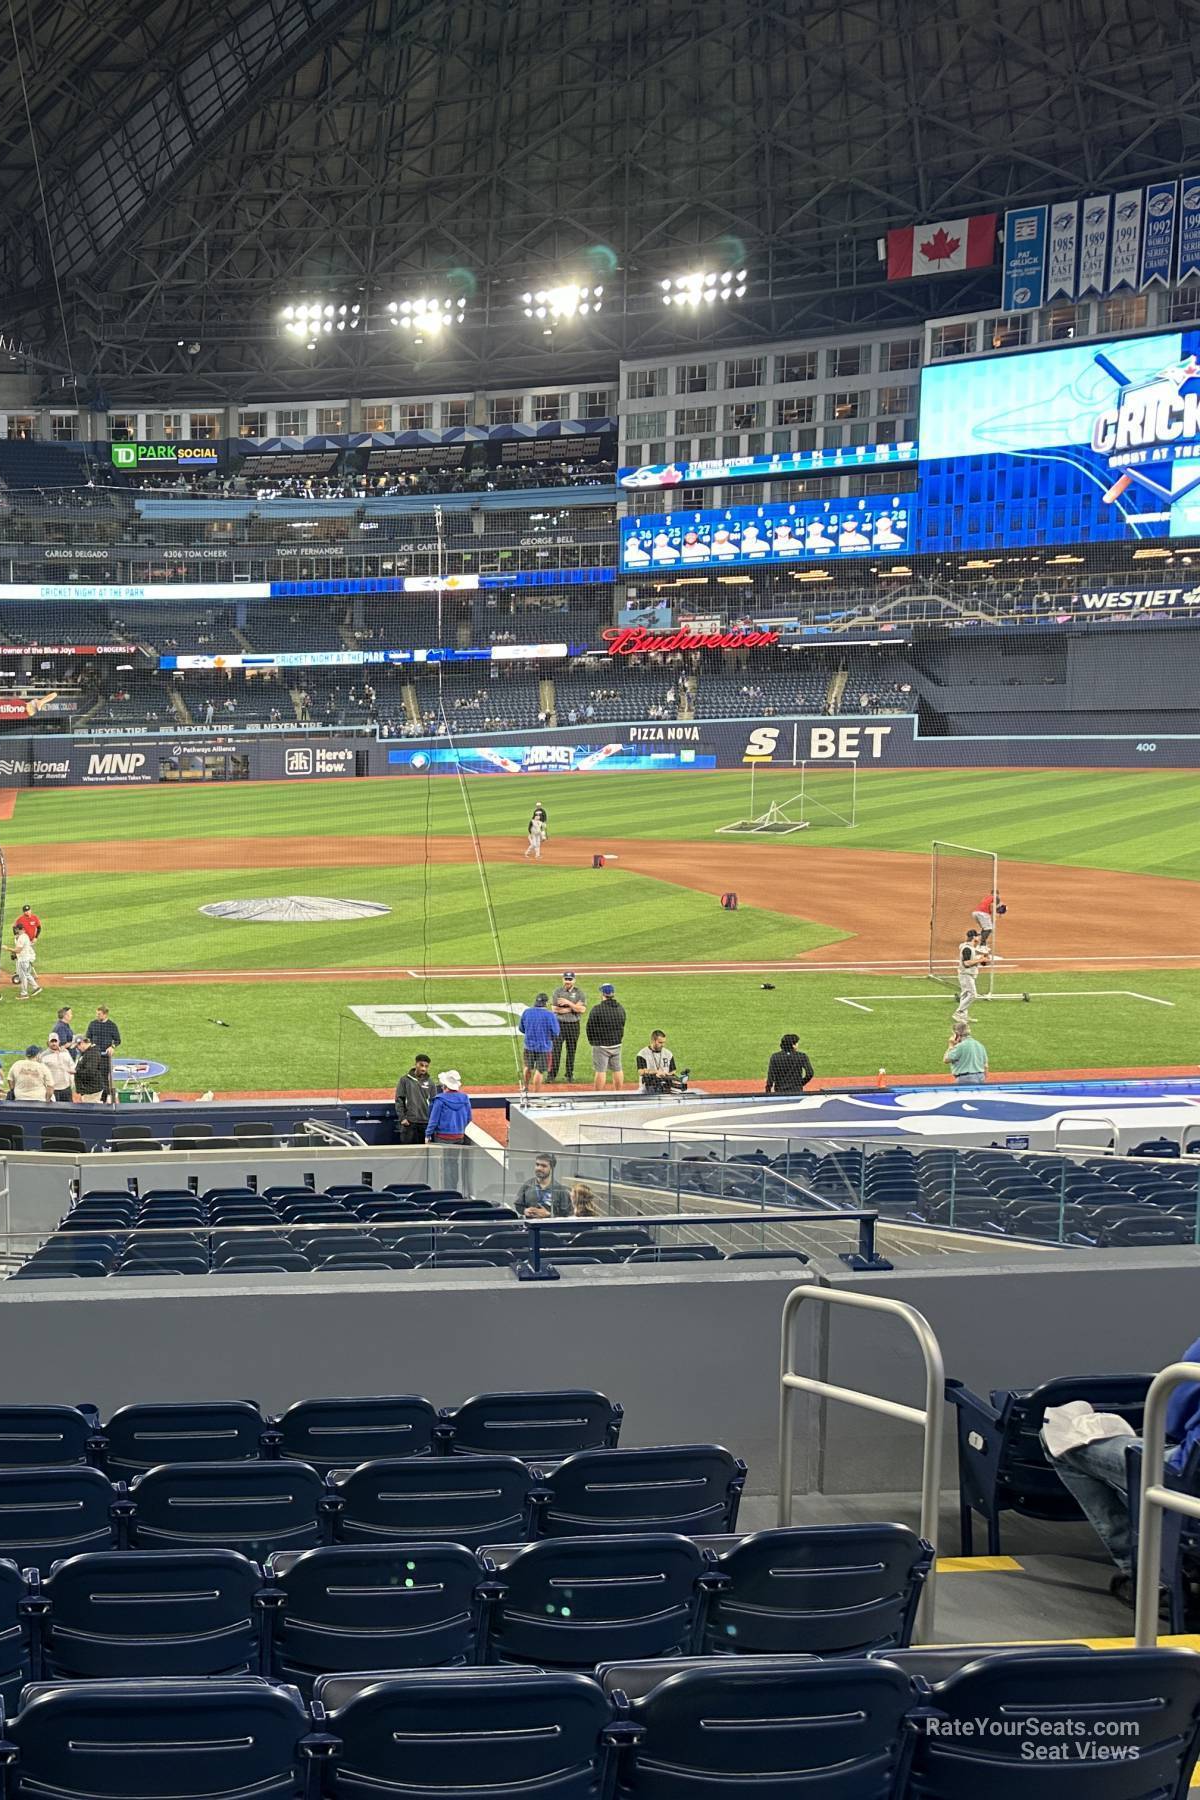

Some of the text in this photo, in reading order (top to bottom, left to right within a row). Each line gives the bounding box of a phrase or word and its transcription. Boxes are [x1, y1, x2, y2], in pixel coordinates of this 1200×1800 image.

[1184, 213, 1200, 230] 199
[1148, 219, 1171, 236] 1992
[1084, 231, 1105, 247] 1989
[1116, 226, 1137, 242] 1991
[1052, 236, 1074, 253] 1985
[1147, 236, 1170, 247] WORLD
[1017, 250, 1031, 258] PAT
[1146, 248, 1169, 258] SERIES
[1009, 256, 1039, 267] GILLICK
[1083, 260, 1102, 271] EAST
[1114, 254, 1135, 267] EAST
[1145, 259, 1169, 269] CHAMPS
[1051, 263, 1072, 276] EAST
[1091, 393, 1200, 453] CRICK
[113, 445, 218, 464] TD PARK SOCIAL
[1108, 451, 1147, 468] NIGHT
[1152, 448, 1169, 460] AT
[823, 501, 830, 512] 7
[864, 512, 872, 522] 7
[891, 509, 907, 520] 28
[635, 518, 641, 528] 1
[733, 522, 741, 532] 2
[794, 518, 805, 527] 11
[639, 530, 652, 539] 36
[668, 527, 681, 537] 25
[697, 524, 711, 534] 27
[520, 535, 575, 546] GEORGE BELL
[276, 547, 344, 556] TONY FERNANDEZ
[399, 542, 447, 551] JOE CARTR
[44, 550, 109, 558] CARLOS DELGADO
[163, 550, 227, 558] 4306 TOM CHEEK
[40, 587, 145, 597] CRICKET NIGHT AT THE PARK
[602, 626, 779, 655] Budweiser
[23, 647, 31, 655] of
[31, 647, 43, 655] the
[43, 646, 59, 654] Blue
[59, 646, 76, 656] Jays
[276, 656, 307, 665] CRICKET
[310, 654, 334, 664] NIGHT
[335, 653, 346, 663] AT
[346, 653, 361, 662] THE
[363, 652, 385, 663] PARK
[126, 726, 148, 734] TIRE
[177, 725, 211, 734] NEXEN
[212, 724, 235, 733] TIRE
[263, 723, 297, 731] NEXEN
[298, 722, 323, 730] TIRE
[629, 726, 700, 741] PIZZA NOVA
[810, 726, 892, 758] BET
[1135, 743, 1157, 752] 400
[182, 744, 236, 755] Pathways Alliance
[316, 749, 353, 760] Here's
[522, 746, 575, 765] CRICKET
[87, 753, 146, 775] MNP
[316, 762, 346, 773] How.
